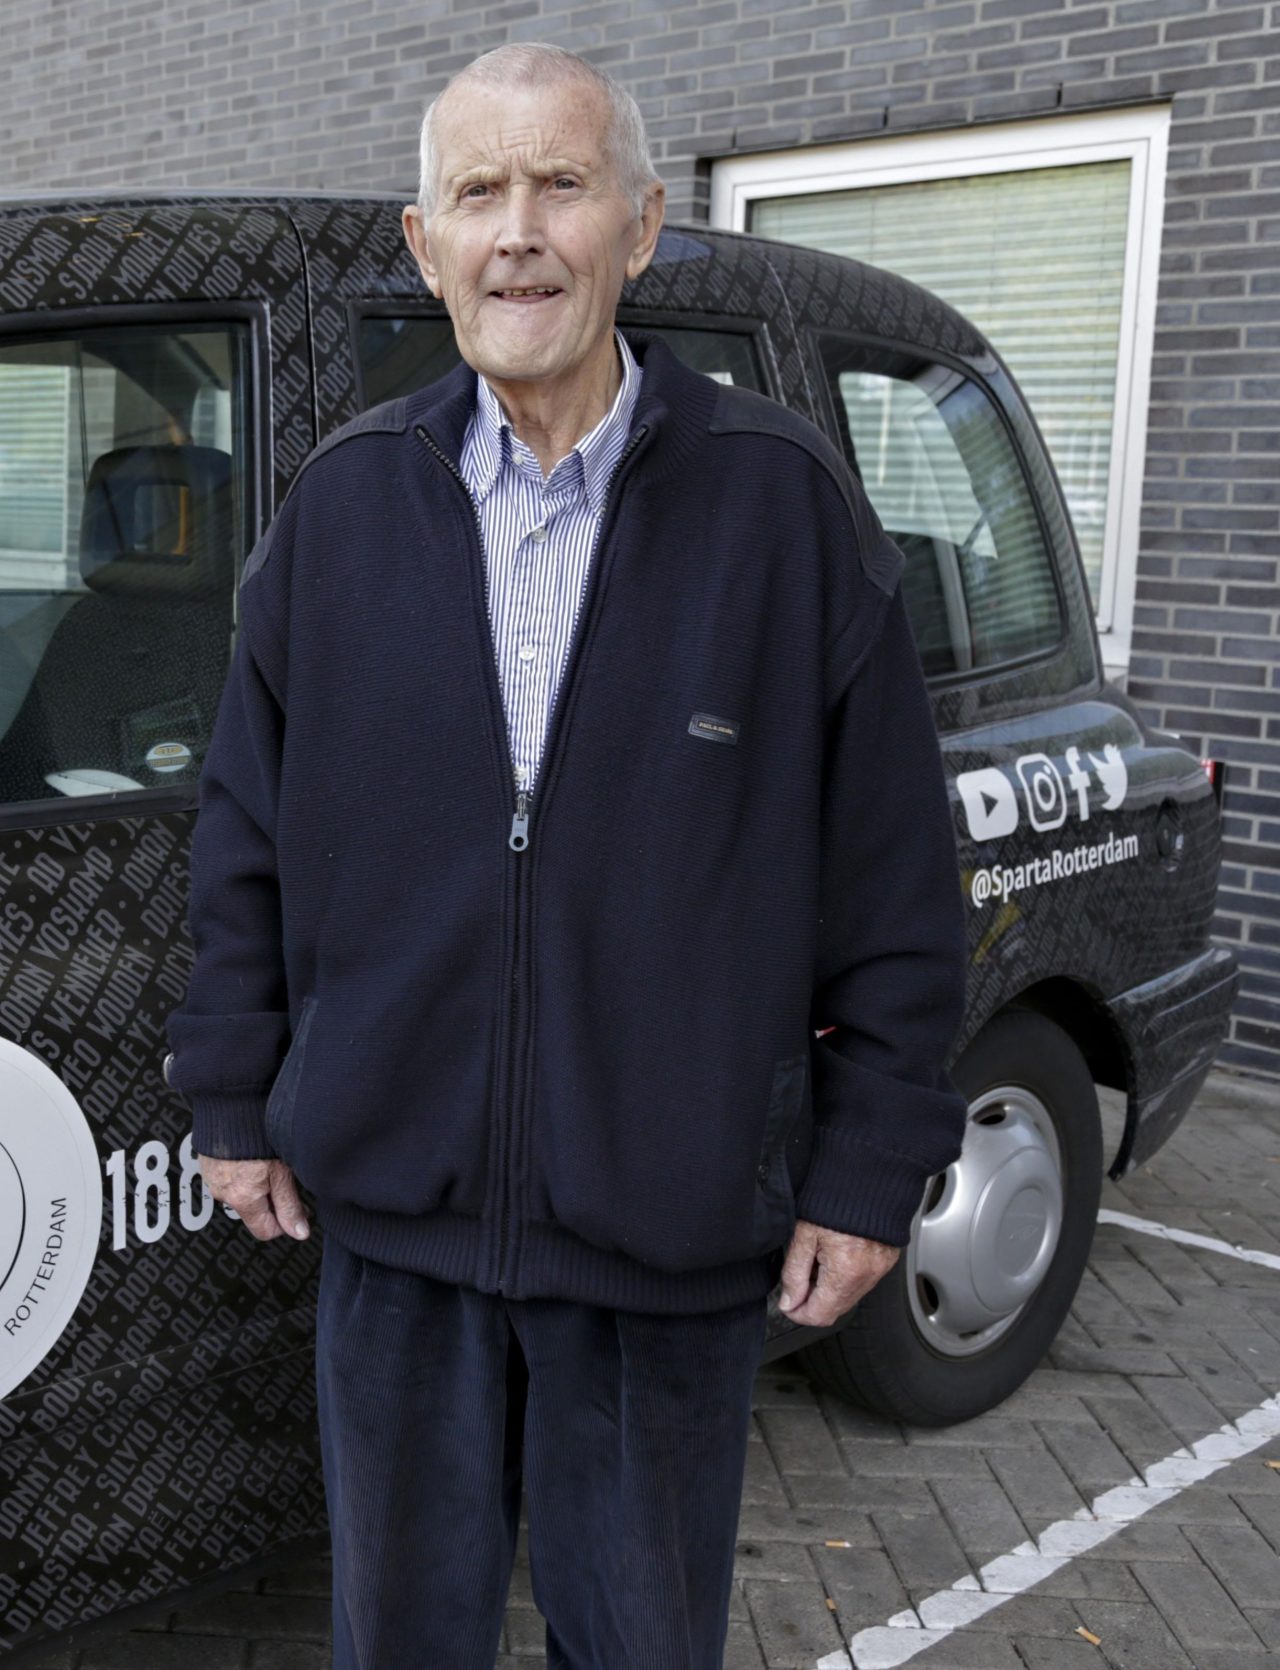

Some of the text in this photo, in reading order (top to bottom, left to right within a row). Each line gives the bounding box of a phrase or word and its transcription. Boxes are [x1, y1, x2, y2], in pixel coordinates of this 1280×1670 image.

[0, 228, 72, 309] ONSMAN
[59, 235, 117, 300] SJAAK
[26, 852, 66, 896] AD
[29, 845, 114, 961] VOSKAMP
[119, 818, 177, 902] JOHAN
[972, 832, 1139, 908] @SpartaRotterdam
[43, 908, 126, 1034] WENNEKER
[86, 943, 156, 1042] WOUDEN
[81, 1009, 165, 1124] ADELEYE
[106, 1131, 242, 1250] 188
[4, 1197, 67, 1336] ROTTERDAM
[171, 1273, 225, 1342] ALEX
[30, 1324, 115, 1434] BOUMAN
[114, 1295, 172, 1369] HANS
[21, 1446, 100, 1559] JEFFREY
[95, 1419, 158, 1499] SILVIO
[164, 1434, 255, 1562] FERGUSON
[170, 1407, 235, 1501] EISDEN
[5, 1511, 98, 1633] DIJKSTRA
[42, 1571, 96, 1631] RICK
[86, 1513, 135, 1566] VAN
